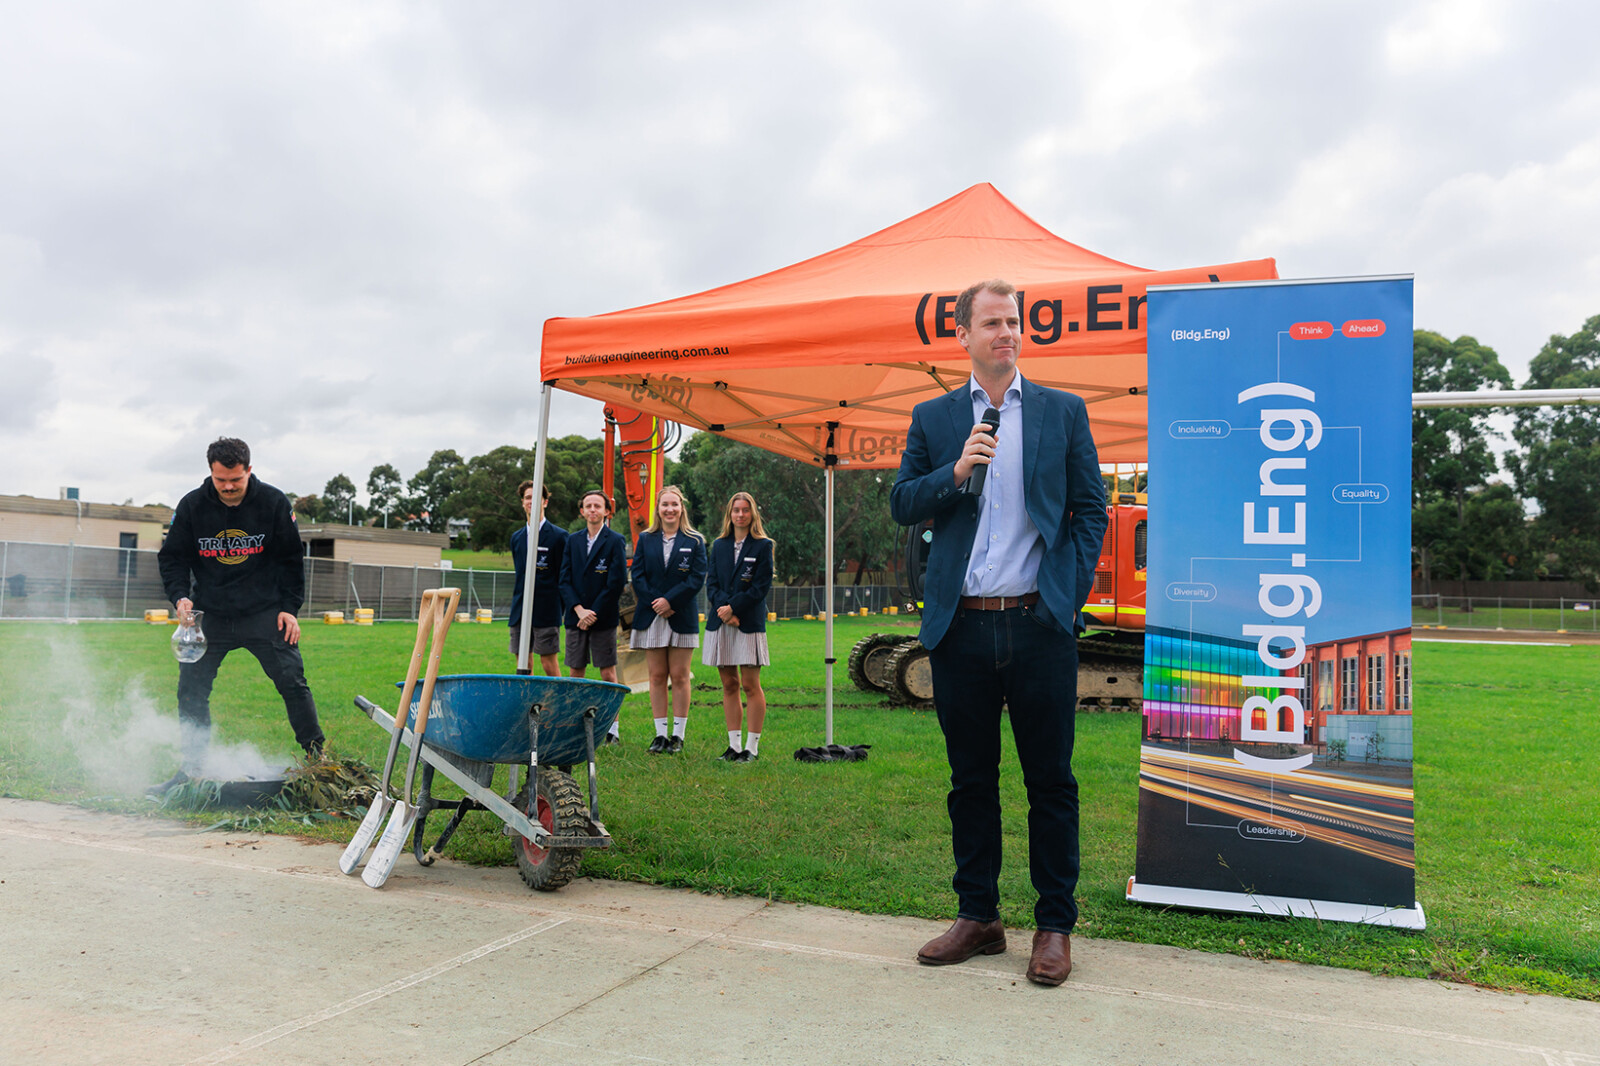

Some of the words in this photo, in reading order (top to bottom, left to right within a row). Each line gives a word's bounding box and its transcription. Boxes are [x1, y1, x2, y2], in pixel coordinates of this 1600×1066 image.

[1171, 327, 1230, 341] (Bldg.Eng)
[1299, 326, 1323, 335] Think
[1348, 324, 1379, 333] Ahead
[565, 346, 729, 365] buildingengineering.com.au
[1178, 426, 1221, 435] Inclusivity
[1342, 489, 1380, 499] Equality
[198, 534, 266, 551] TREATY
[199, 549, 218, 557] FOR
[1234, 381, 1323, 774] (Bldg.Eng)
[1173, 587, 1209, 598] Diversity
[1246, 825, 1297, 838] Leadership
